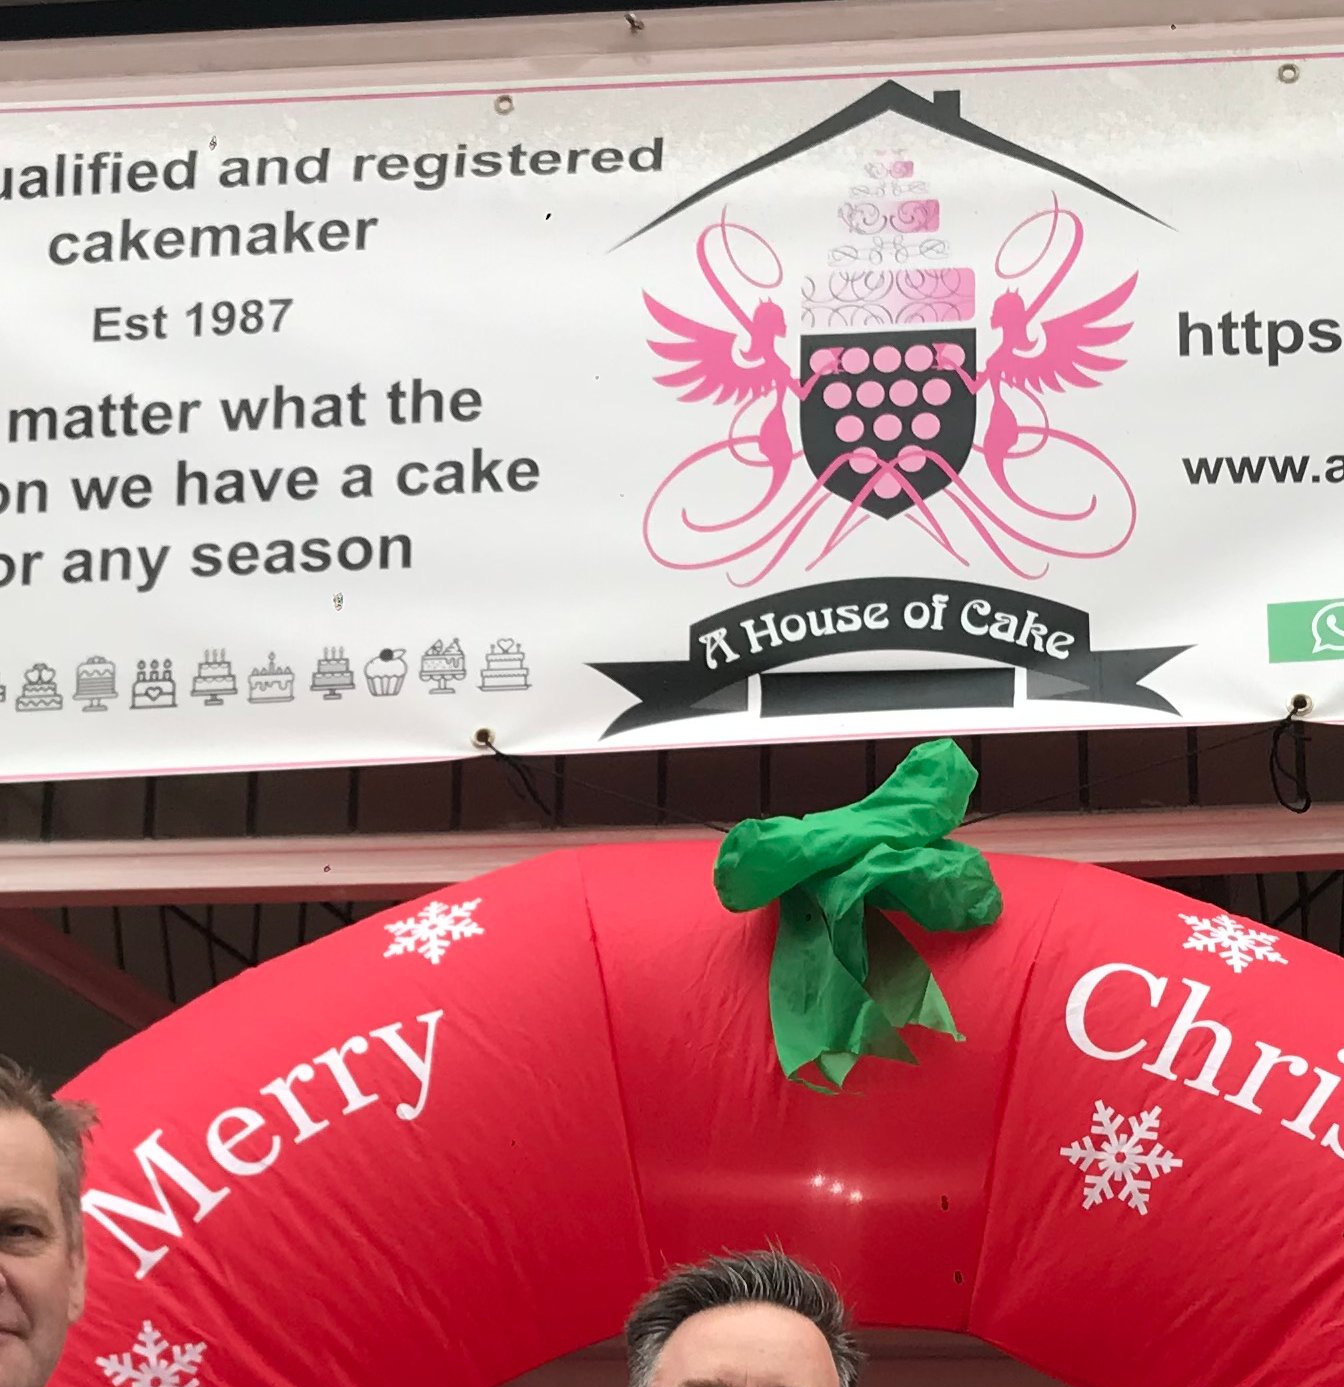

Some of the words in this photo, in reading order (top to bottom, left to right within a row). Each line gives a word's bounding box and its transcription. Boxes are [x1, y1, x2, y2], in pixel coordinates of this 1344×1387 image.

[219, 147, 330, 188] and
[353, 136, 664, 191] registered
[49, 210, 378, 266] cakemaker
[93, 306, 167, 342] Est
[187, 298, 293, 337] 1987
[8, 394, 200, 443] matter
[220, 383, 366, 431] what
[387, 378, 482, 425] the
[71, 474, 152, 511] we
[176, 460, 318, 506] have
[341, 464, 372, 498] a
[397, 447, 540, 496] cake
[62, 545, 170, 593] any
[191, 534, 412, 577] season
[698, 627, 741, 670] A
[747, 599, 890, 654] House
[904, 593, 950, 631] of
[960, 598, 1075, 660] Cake
[81, 1009, 444, 1281] Merry
